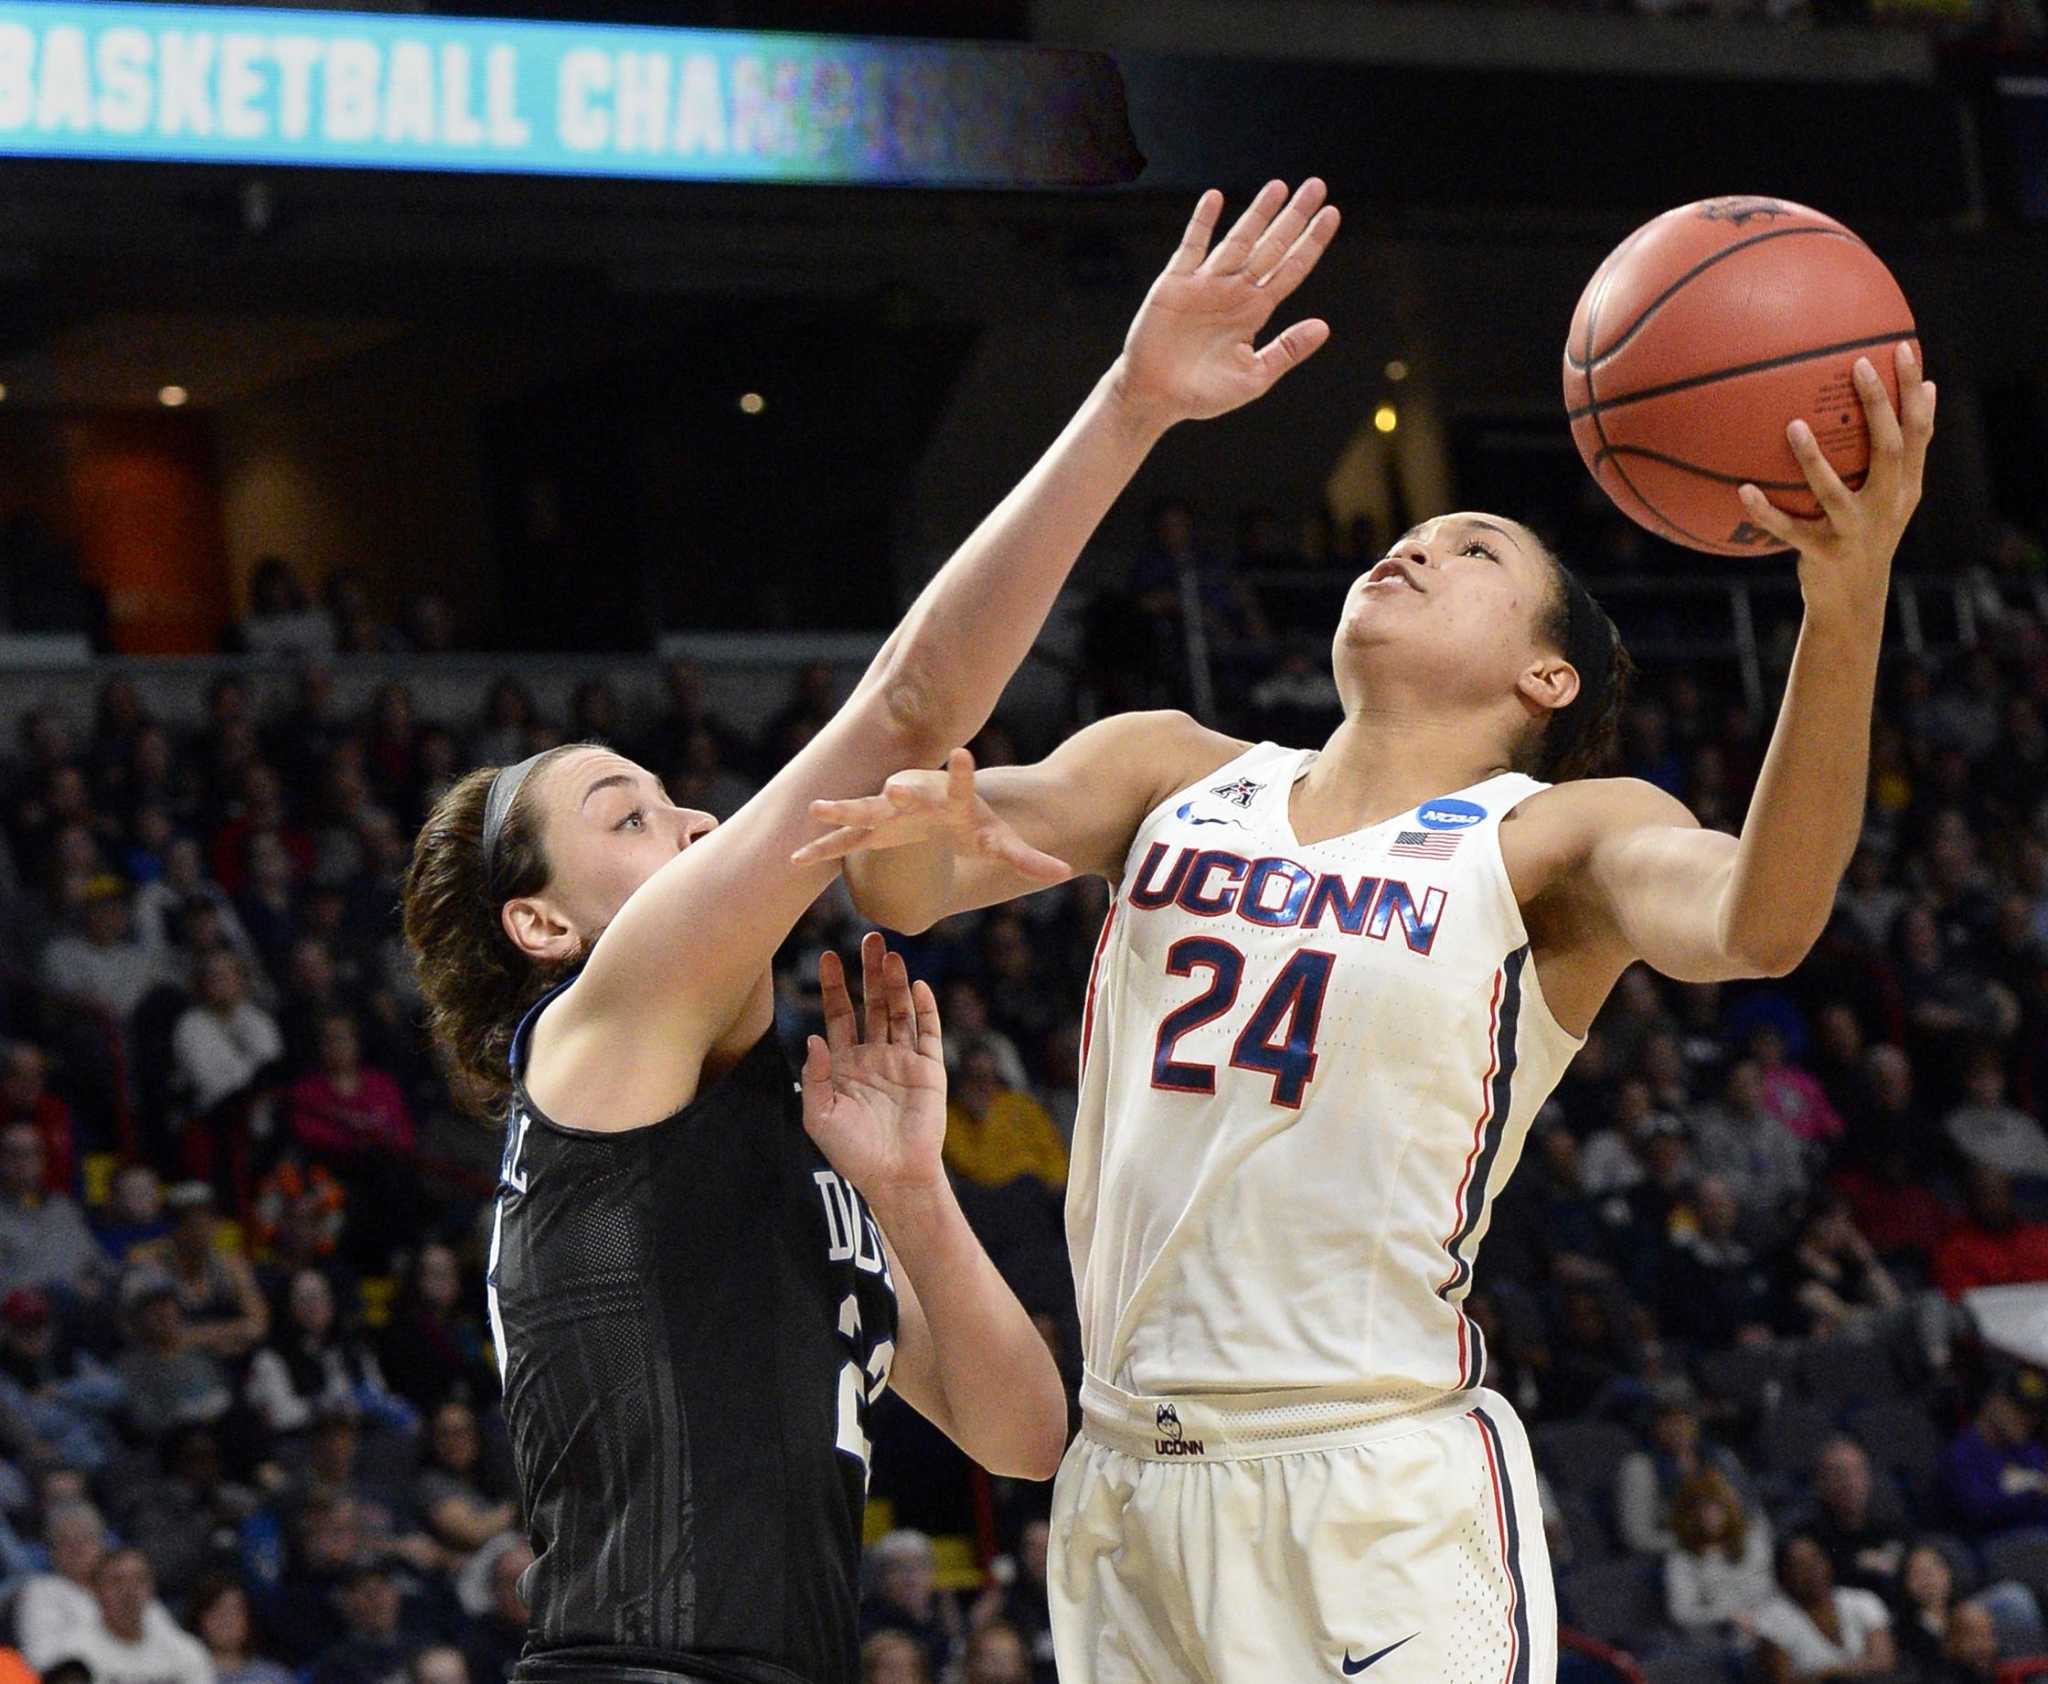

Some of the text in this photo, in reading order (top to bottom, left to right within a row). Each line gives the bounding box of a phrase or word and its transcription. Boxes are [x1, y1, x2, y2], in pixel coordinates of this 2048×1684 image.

[1128, 841, 1449, 956] UCONN
[1150, 935, 1337, 1110] 24
[1154, 1439, 1204, 1455] UCONN
